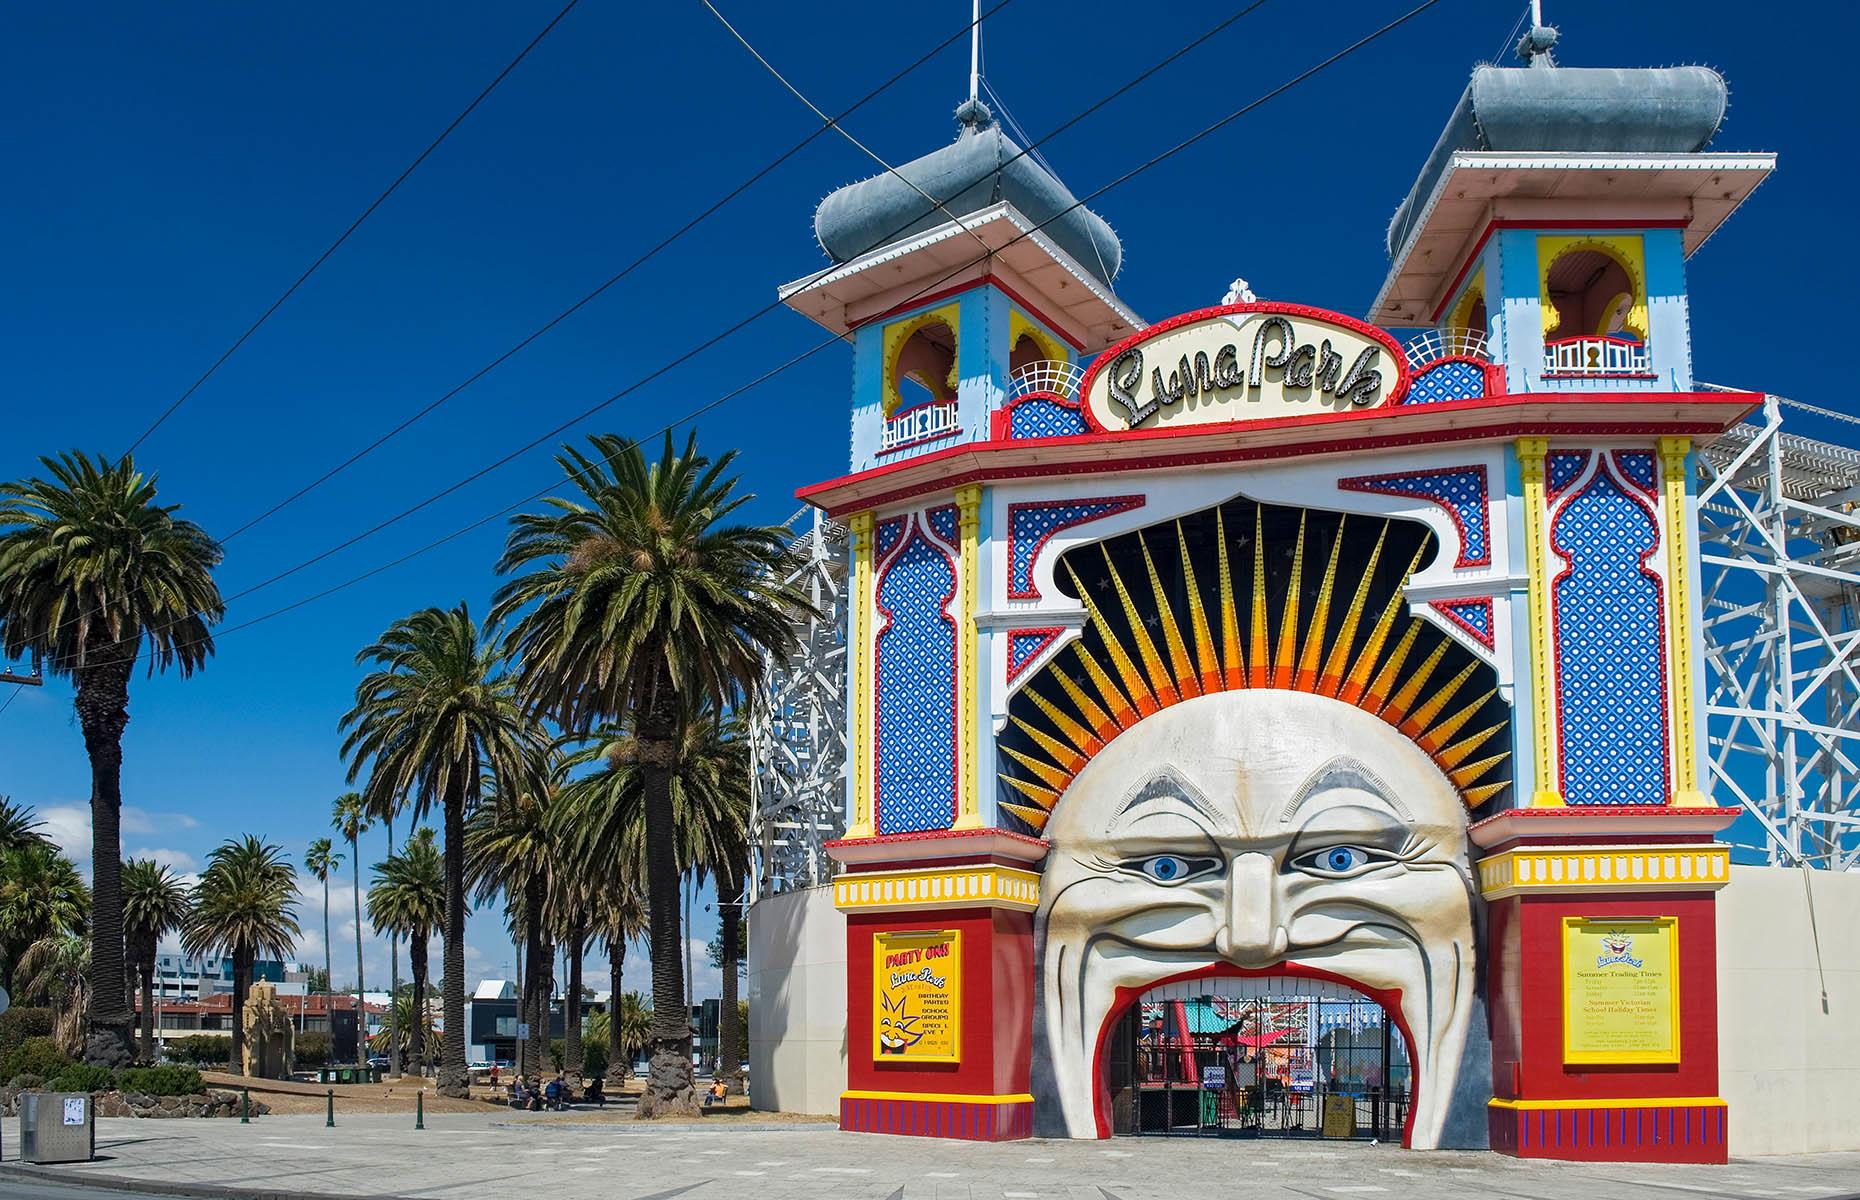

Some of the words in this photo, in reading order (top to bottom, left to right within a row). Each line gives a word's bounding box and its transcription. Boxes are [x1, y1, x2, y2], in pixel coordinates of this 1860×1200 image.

[1108, 343, 1244, 427] Luna
[1248, 316, 1382, 405] Park
[886, 949, 922, 969] PARTY
